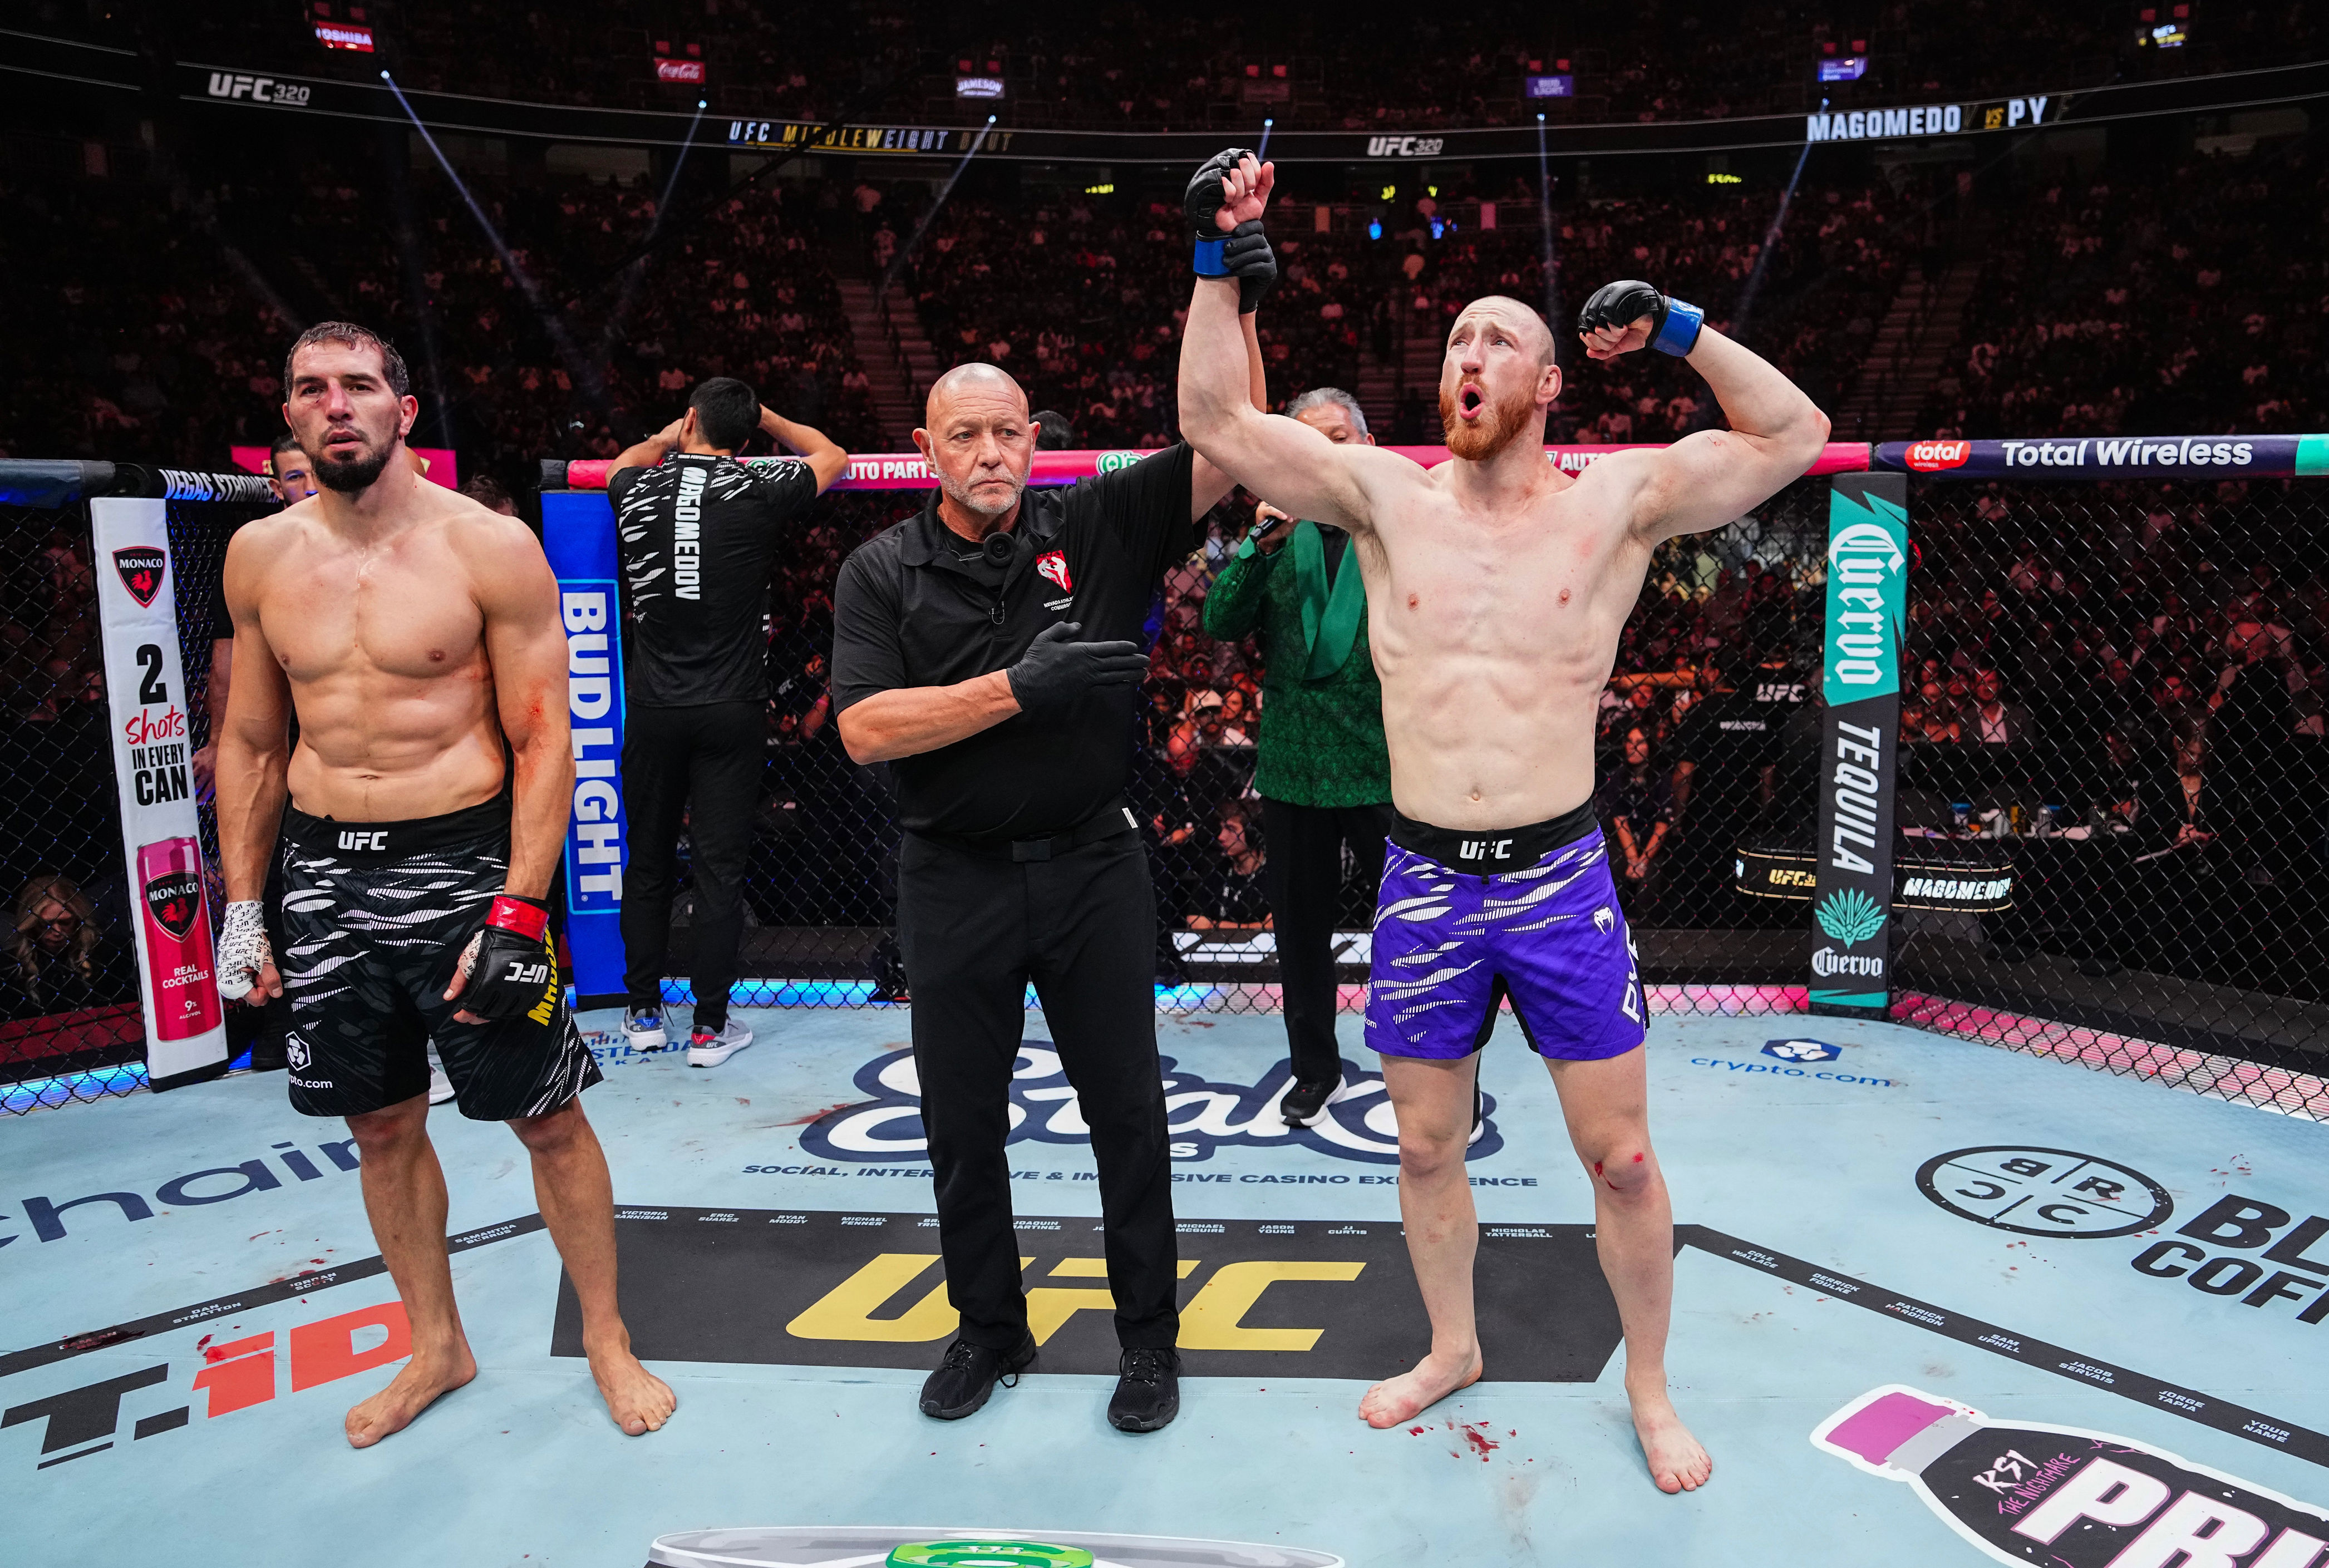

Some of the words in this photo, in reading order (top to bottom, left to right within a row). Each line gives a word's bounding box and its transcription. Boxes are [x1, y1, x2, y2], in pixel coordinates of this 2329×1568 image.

[209, 72, 274, 101] UFC
[272, 83, 311, 106] 320
[728, 121, 770, 141] UFC
[1367, 136, 1417, 156] UFC
[1913, 442, 1964, 460] total
[2002, 439, 2089, 467] Total
[2096, 437, 2253, 466] Wireless
[158, 469, 214, 501] VEGAS
[673, 466, 708, 600] MAGOMEDOV
[119, 558, 164, 569] MONACO
[1828, 523, 1905, 685] Cuervo
[563, 592, 613, 719] BUD
[136, 644, 168, 704] 2
[1756, 683, 1806, 703] UFC
[125, 705, 185, 745] shots
[132, 747, 146, 770] IN
[148, 743, 184, 767] EVERY
[134, 765, 189, 806] CAN
[1831, 720, 1880, 875] TEQUILA
[572, 727, 623, 901] LIGHT
[337, 831, 388, 851] UFC
[1769, 869, 1806, 886] UFC
[149, 882, 199, 902] MONACO
[174, 964, 198, 977] REAL
[1811, 946, 1883, 977] Cuervo
[162, 969, 209, 989] COCKTAILS
[504, 962, 549, 984] UFC
[1691, 1057, 1891, 1087] crypto.com
[741, 1165, 850, 1179] SOCIAL,
[1239, 1174, 1350, 1185] CASINO
[454, 1224, 517, 1244] SAMANTHA
[1732, 1249, 1779, 1269] WALLACE
[1747, 1249, 1775, 1262] COLE
[1809, 1277, 1852, 1295] FOULKE
[1811, 1273, 1861, 1292] DERRICK
[191, 1303, 220, 1314] DAN
[785, 1253, 1367, 1351] UFC
[1895, 1301, 1946, 1322] PATRICK
[173, 1302, 242, 1324] STRATTON
[1885, 1304, 1945, 1327] HARDISON
[1977, 1335, 2021, 1353] UPHILL
[1991, 1334, 2020, 1347] SAM
[2059, 1362, 2115, 1384] SERVAIS
[2069, 1360, 2114, 1378] JACOB
[2158, 1390, 2205, 1408] JORGE
[2158, 1394, 2197, 1412] TAPIA
[2242, 1424, 2288, 1443] NAME
[2250, 1419, 2291, 1437] YOUR
[1972, 1449, 2039, 1495] KSI
[1998, 1496, 2030, 1515] THE
[2014, 1452, 2081, 1501] NIGHTMARE
